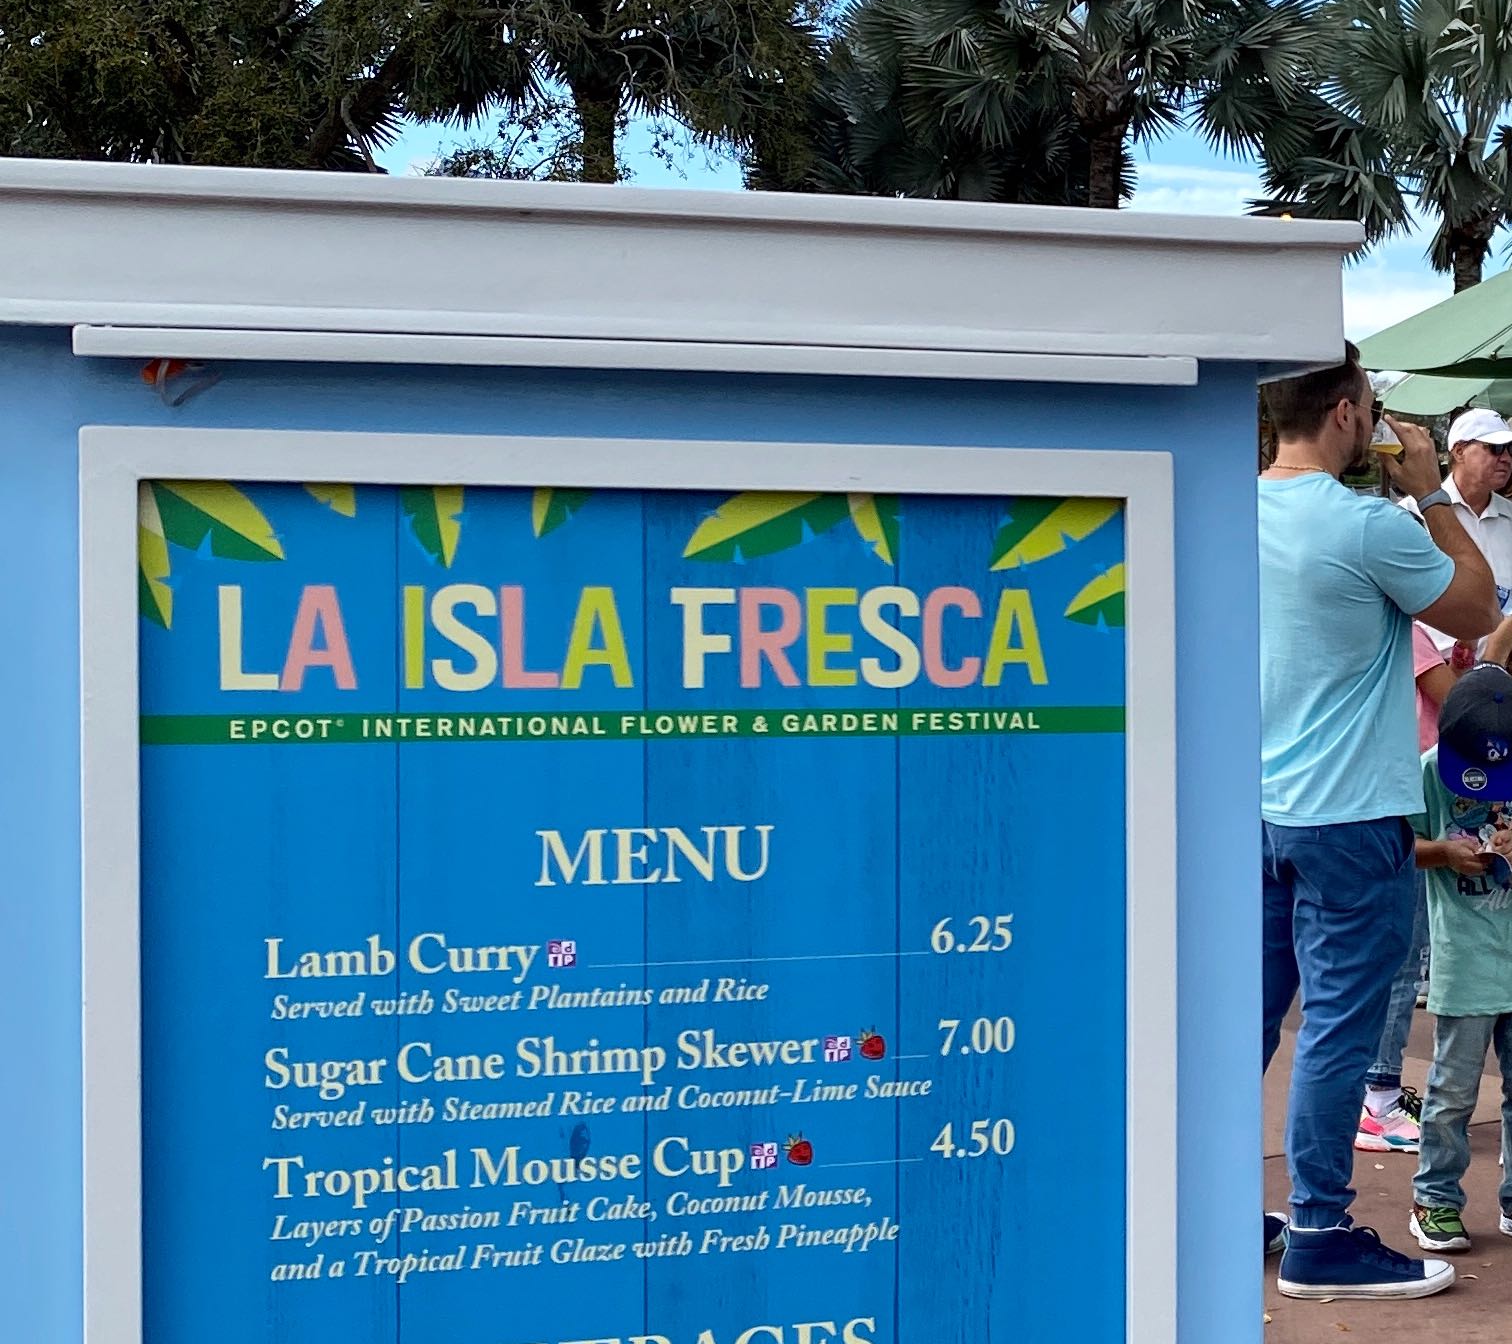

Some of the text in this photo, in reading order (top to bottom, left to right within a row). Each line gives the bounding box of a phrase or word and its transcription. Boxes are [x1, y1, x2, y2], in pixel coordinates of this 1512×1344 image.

[218, 585, 1048, 692] LA ISLA FRESCA
[363, 717, 605, 737] INTERNATIONAL
[621, 715, 738, 734] FLOWER
[752, 716, 768, 732] &
[782, 714, 897, 732] GARDEN
[912, 712, 1040, 730] FESTIVAL
[535, 825, 774, 886] MENU
[264, 914, 1013, 984] Lamb Curry 6.25
[271, 979, 769, 1019] Served with Sweet Plantains and Rice
[265, 1017, 1015, 1100] Sugar Cane Shrimp Skewer 7.00
[272, 1075, 932, 1129] Served with Steamed Rice and Coconut-Lime Sauce
[263, 1119, 1015, 1206] Tropical Mousse Cup 4.50
[271, 1186, 872, 1247] Layers of Passion Fruit Cake, Coconut Mousse,
[271, 1218, 899, 1282] and a Tropical Fruit Glaze with Fresh Pineapple
